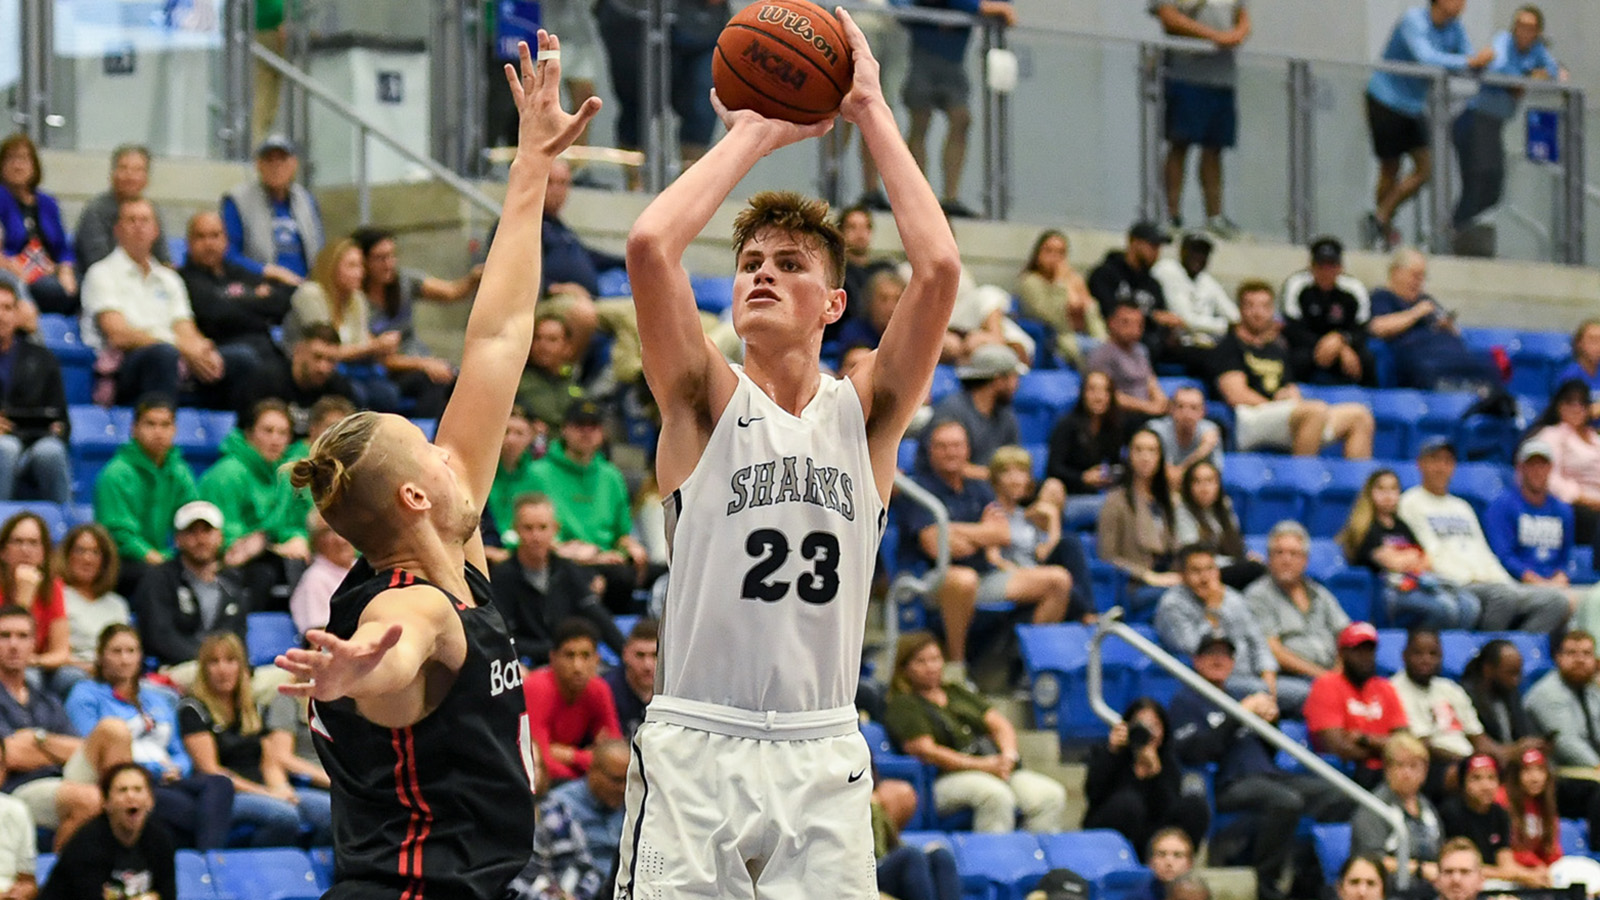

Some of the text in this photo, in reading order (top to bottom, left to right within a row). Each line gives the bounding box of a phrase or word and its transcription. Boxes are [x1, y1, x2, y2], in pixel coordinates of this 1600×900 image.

[742, 39, 808, 90] NCAA
[757, 5, 838, 68] Wilson
[740, 528, 840, 605] 23
